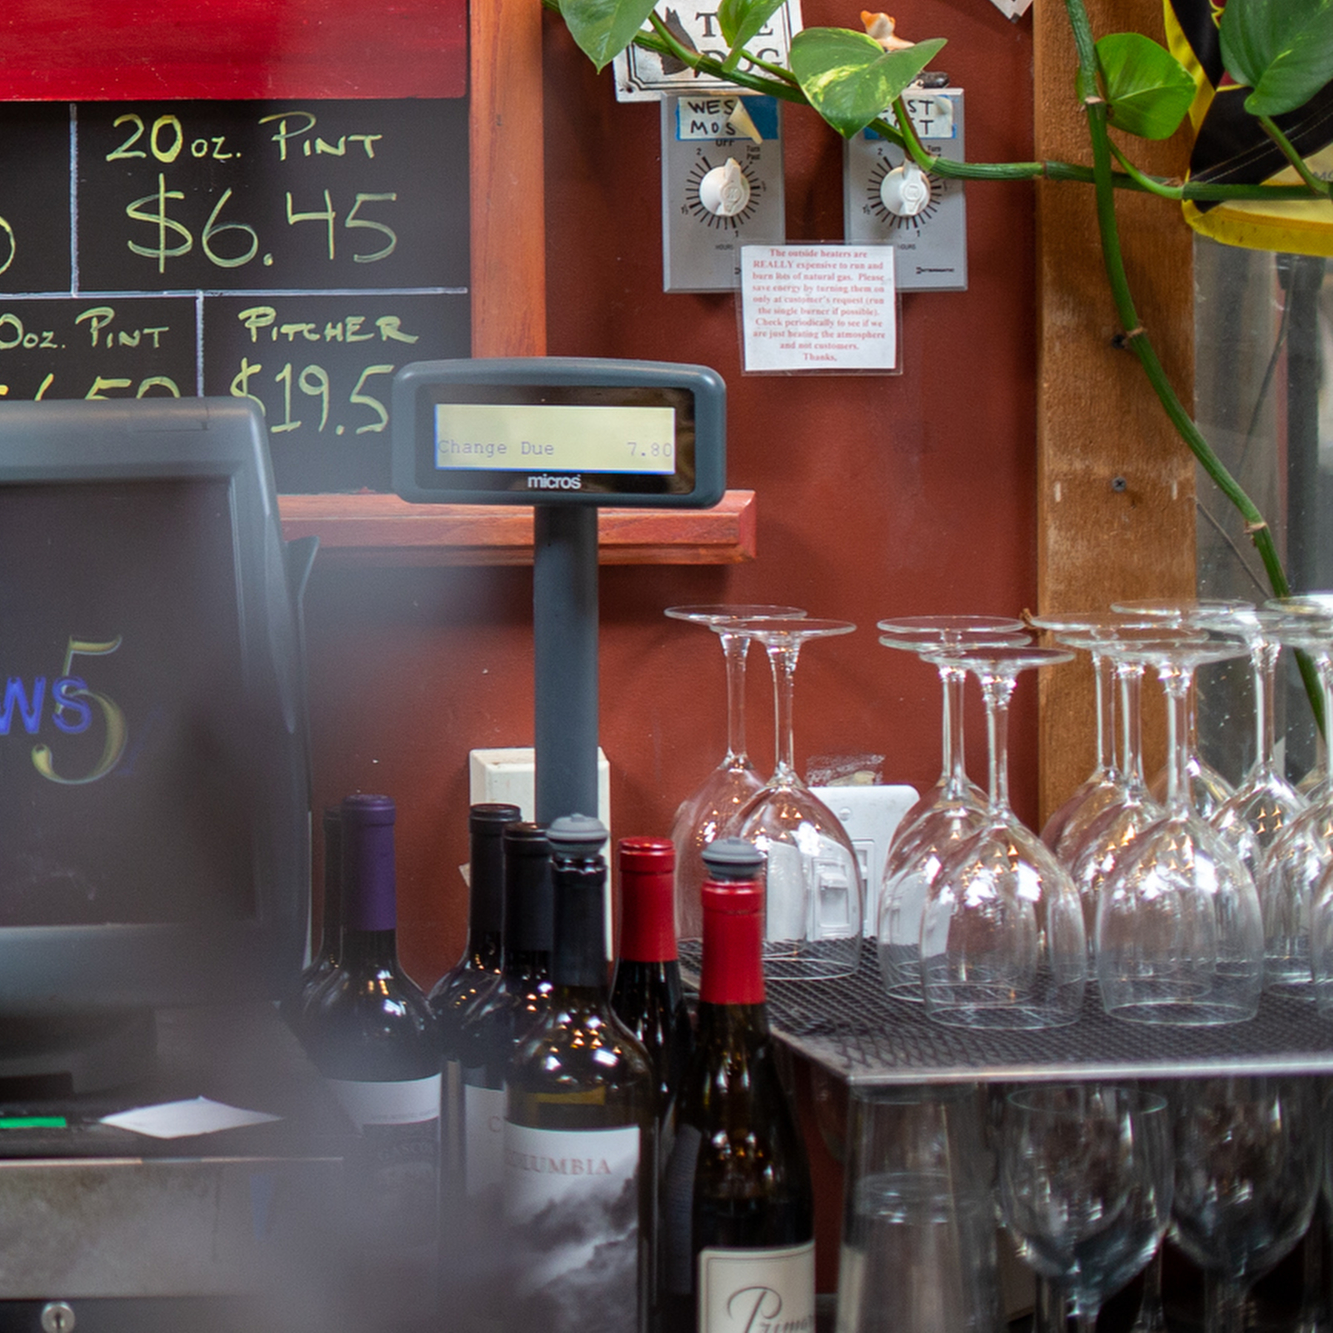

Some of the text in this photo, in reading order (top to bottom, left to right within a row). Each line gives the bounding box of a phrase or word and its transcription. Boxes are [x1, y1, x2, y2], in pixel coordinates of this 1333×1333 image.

[125, 173, 399, 273] $6.45
[237, 304, 421, 345] PITCHER
[438, 440, 508, 458] Change
[520, 440, 555, 456] Due
[527, 475, 582, 489] micros
